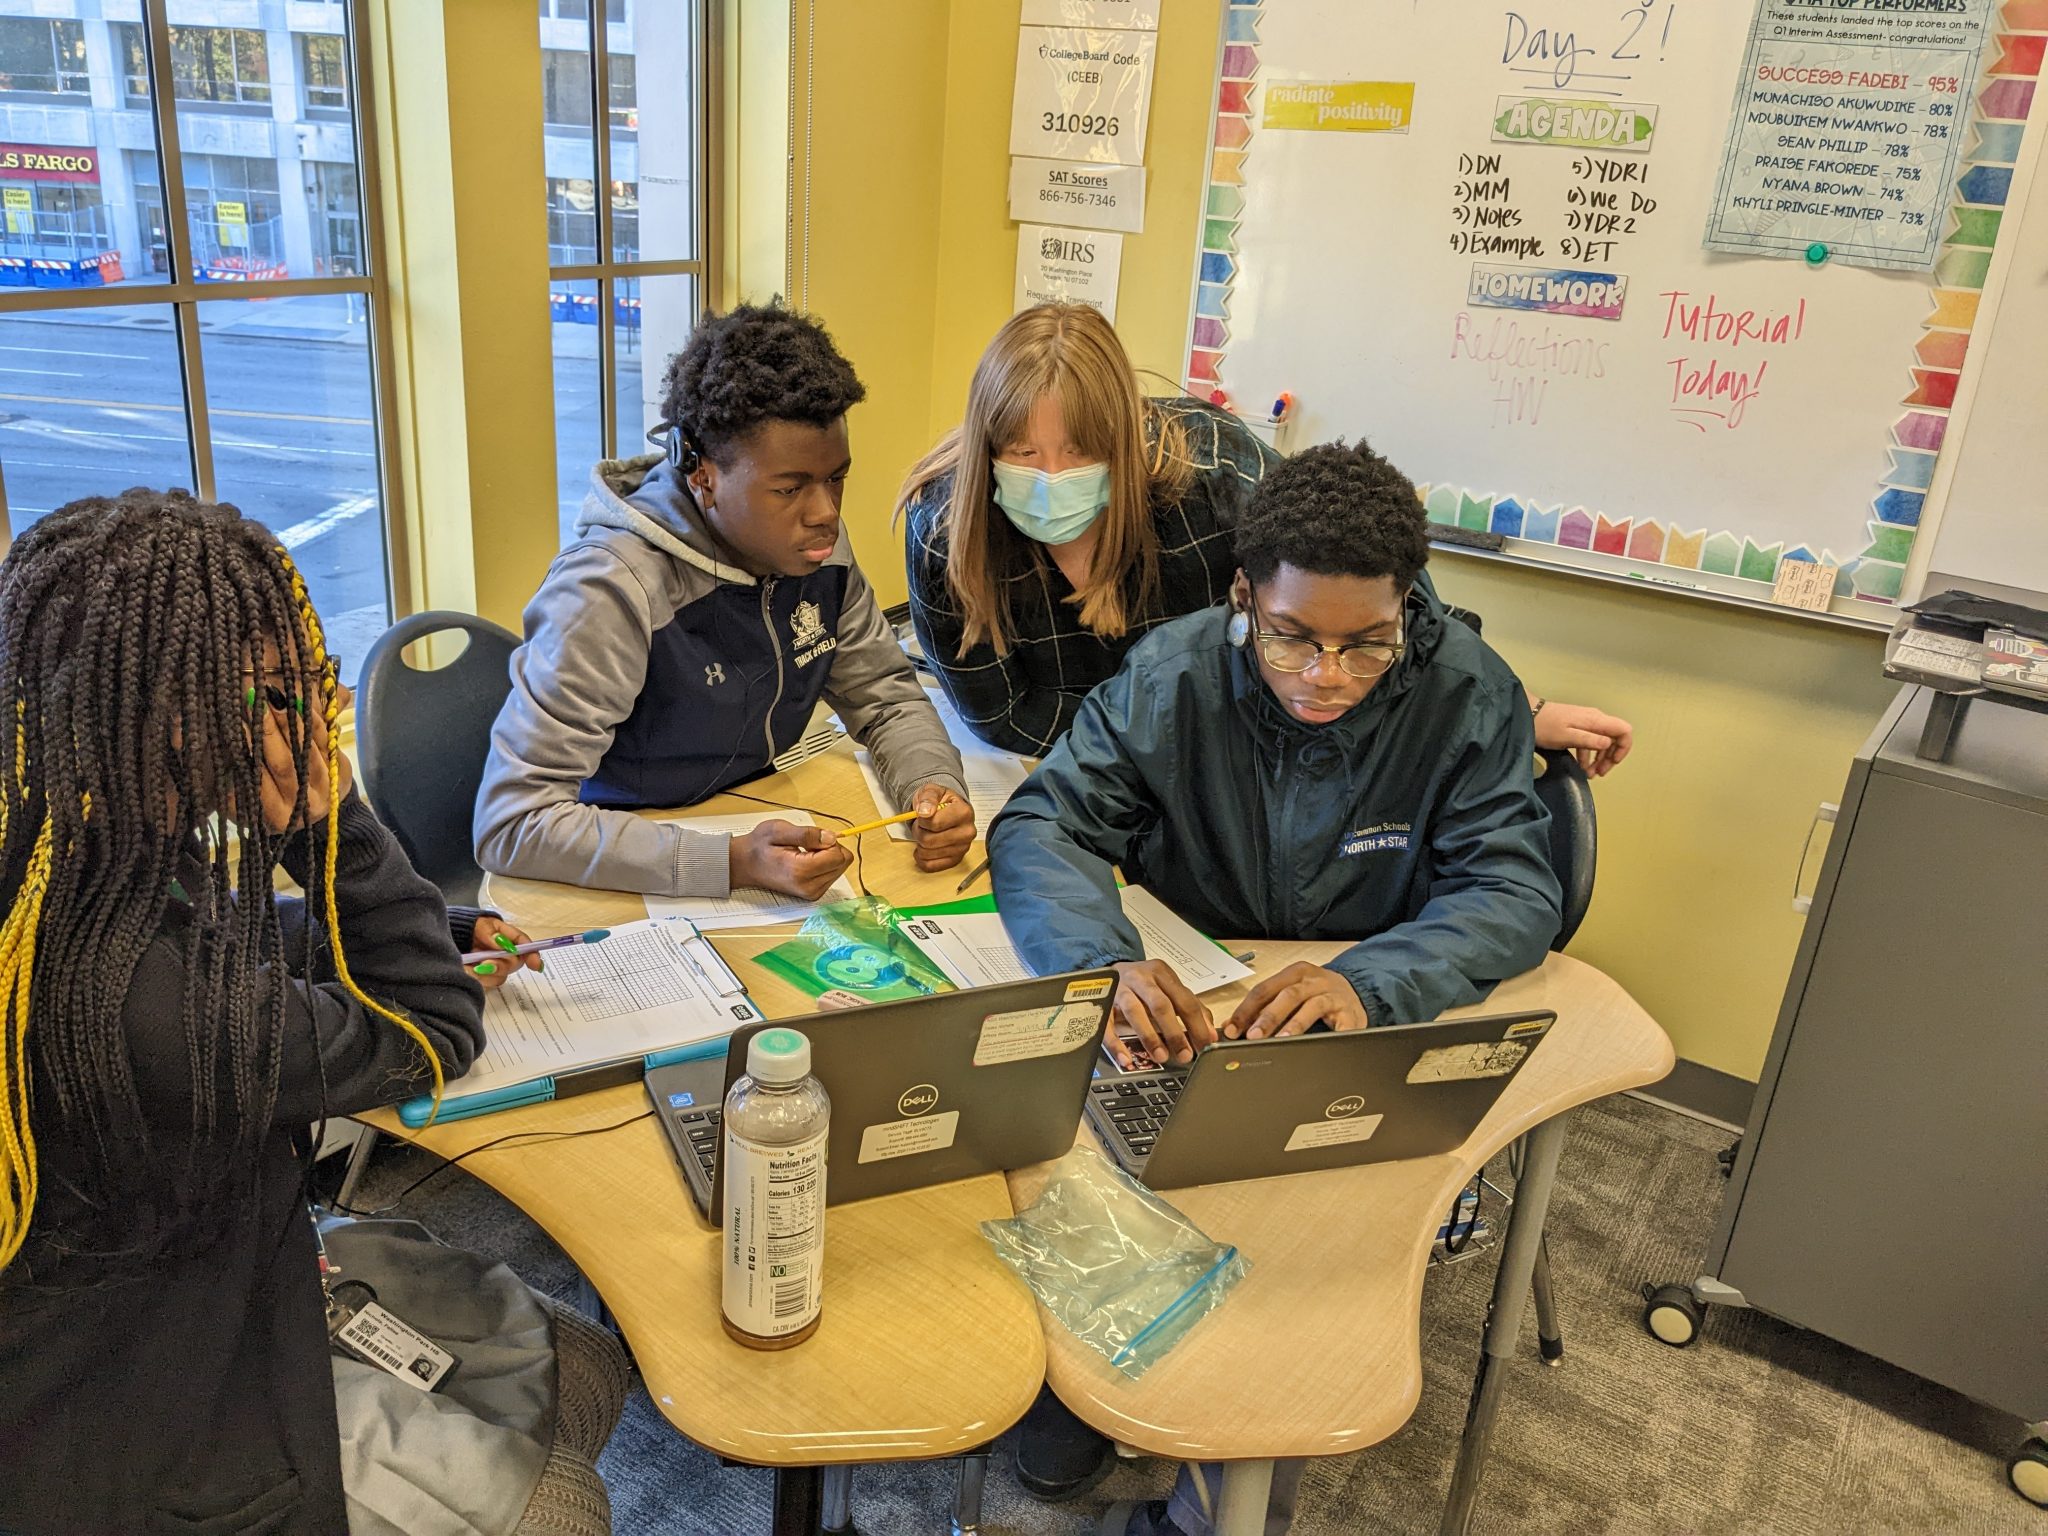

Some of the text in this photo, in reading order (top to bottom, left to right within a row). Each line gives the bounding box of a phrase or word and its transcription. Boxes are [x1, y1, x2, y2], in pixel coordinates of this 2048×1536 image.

[1864, 0, 1967, 12] PERFORMERS
[1767, 10, 1979, 30] These students landed the top scores on the
[1773, 26, 1786, 36] Q1
[1789, 27, 1823, 38] Interim
[1889, 33, 1967, 45] congratulations!
[1113, 52, 1141, 66] Code
[1502, 12, 1596, 88] Day
[1067, 71, 1103, 85] (CEEB)
[1758, 66, 1843, 86] SUCCESS
[1847, 71, 1909, 90] FADEBI
[1928, 77, 1959, 94] 95%
[1271, 84, 1335, 104] radiate
[1753, 91, 1834, 108] MUNACHISO
[1837, 97, 1916, 114] AKUWUDIKE
[1929, 102, 1954, 117] 80%
[1042, 112, 1120, 137] 310926
[1317, 102, 1403, 126] positivity
[1506, 103, 1637, 144] AGENDA
[1748, 111, 1829, 129] NDUBUIKEM
[1831, 119, 1908, 135] NWANKWO
[1922, 124, 1949, 138] 78%
[1777, 136, 1815, 149] SEAN
[1818, 139, 1868, 153] PHILLIP
[1884, 144, 1910, 158] 78%
[22, 153, 93, 173] FARGO
[1755, 155, 1805, 171] PRAISE
[1808, 159, 1879, 177] FAKOREDE
[1895, 167, 1922, 181] 75%
[1048, 170, 1108, 188] SAT Scores
[1762, 177, 1810, 193] NYANA
[1815, 182, 1863, 197] BROWN
[1880, 187, 1905, 202] 74%
[1039, 189, 1117, 208] 866-756-7346
[1733, 196, 1774, 211] KHYLI
[1776, 201, 1884, 221] PRINGLE-MINTER
[1899, 211, 1924, 225] 73%
[1061, 241, 1095, 264] IRS
[1471, 270, 1628, 308] HOMEWORK
[1659, 291, 1806, 347] Tutorial
[1450, 311, 1611, 383] Reflections
[1491, 376, 1549, 429] HW
[1667, 357, 1768, 430] Today!
[1383, 822, 1411, 832] Schools
[1344, 836, 1408, 854] NORTH STAR
[769, 1153, 817, 1170] Nutrition Facts
[793, 1184, 804, 1194] 130
[806, 1179, 816, 1190] 220
[771, 1265, 786, 1277] NO
[380, 1312, 416, 1339] Washington
[415, 1336, 430, 1349] Park
